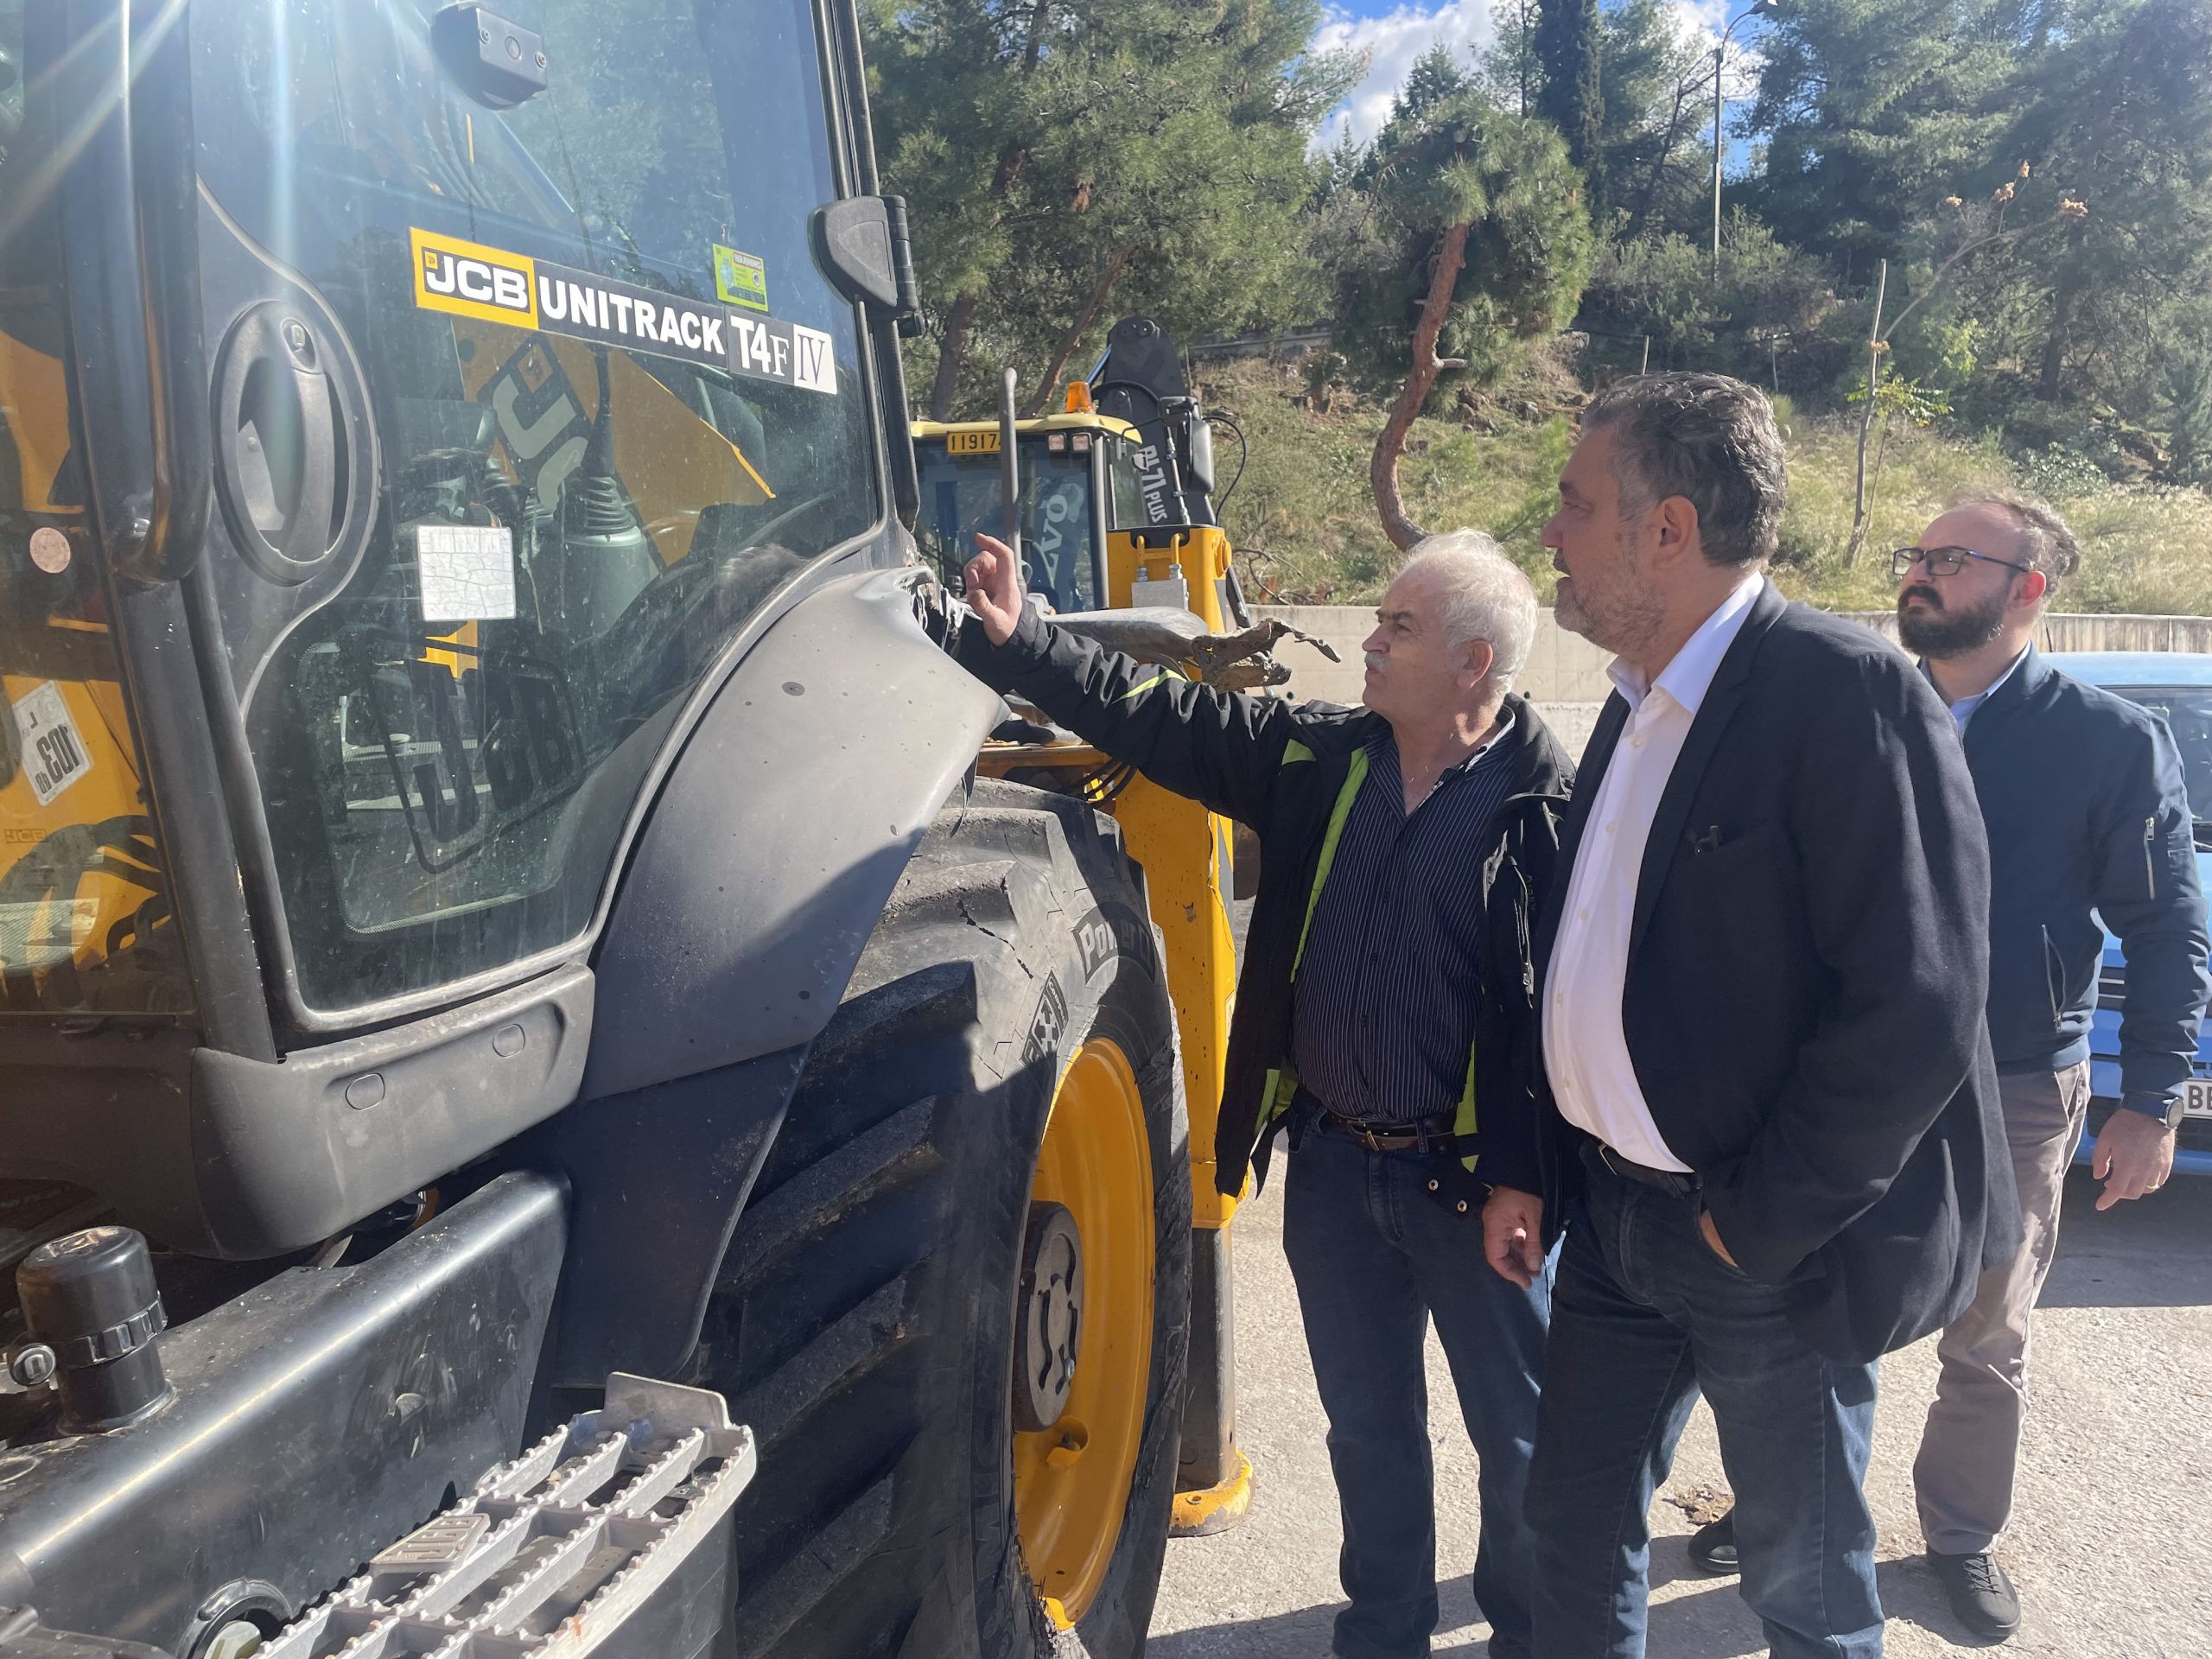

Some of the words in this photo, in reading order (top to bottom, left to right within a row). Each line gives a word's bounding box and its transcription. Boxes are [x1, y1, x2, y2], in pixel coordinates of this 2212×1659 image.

[425, 255, 528, 308] JCB
[539, 276, 725, 355] UNITRACK
[798, 334, 825, 385] IV
[951, 434, 1001, 450] 11917
[1145, 491, 1167, 523] PLUS
[6, 830, 47, 842] JCB
